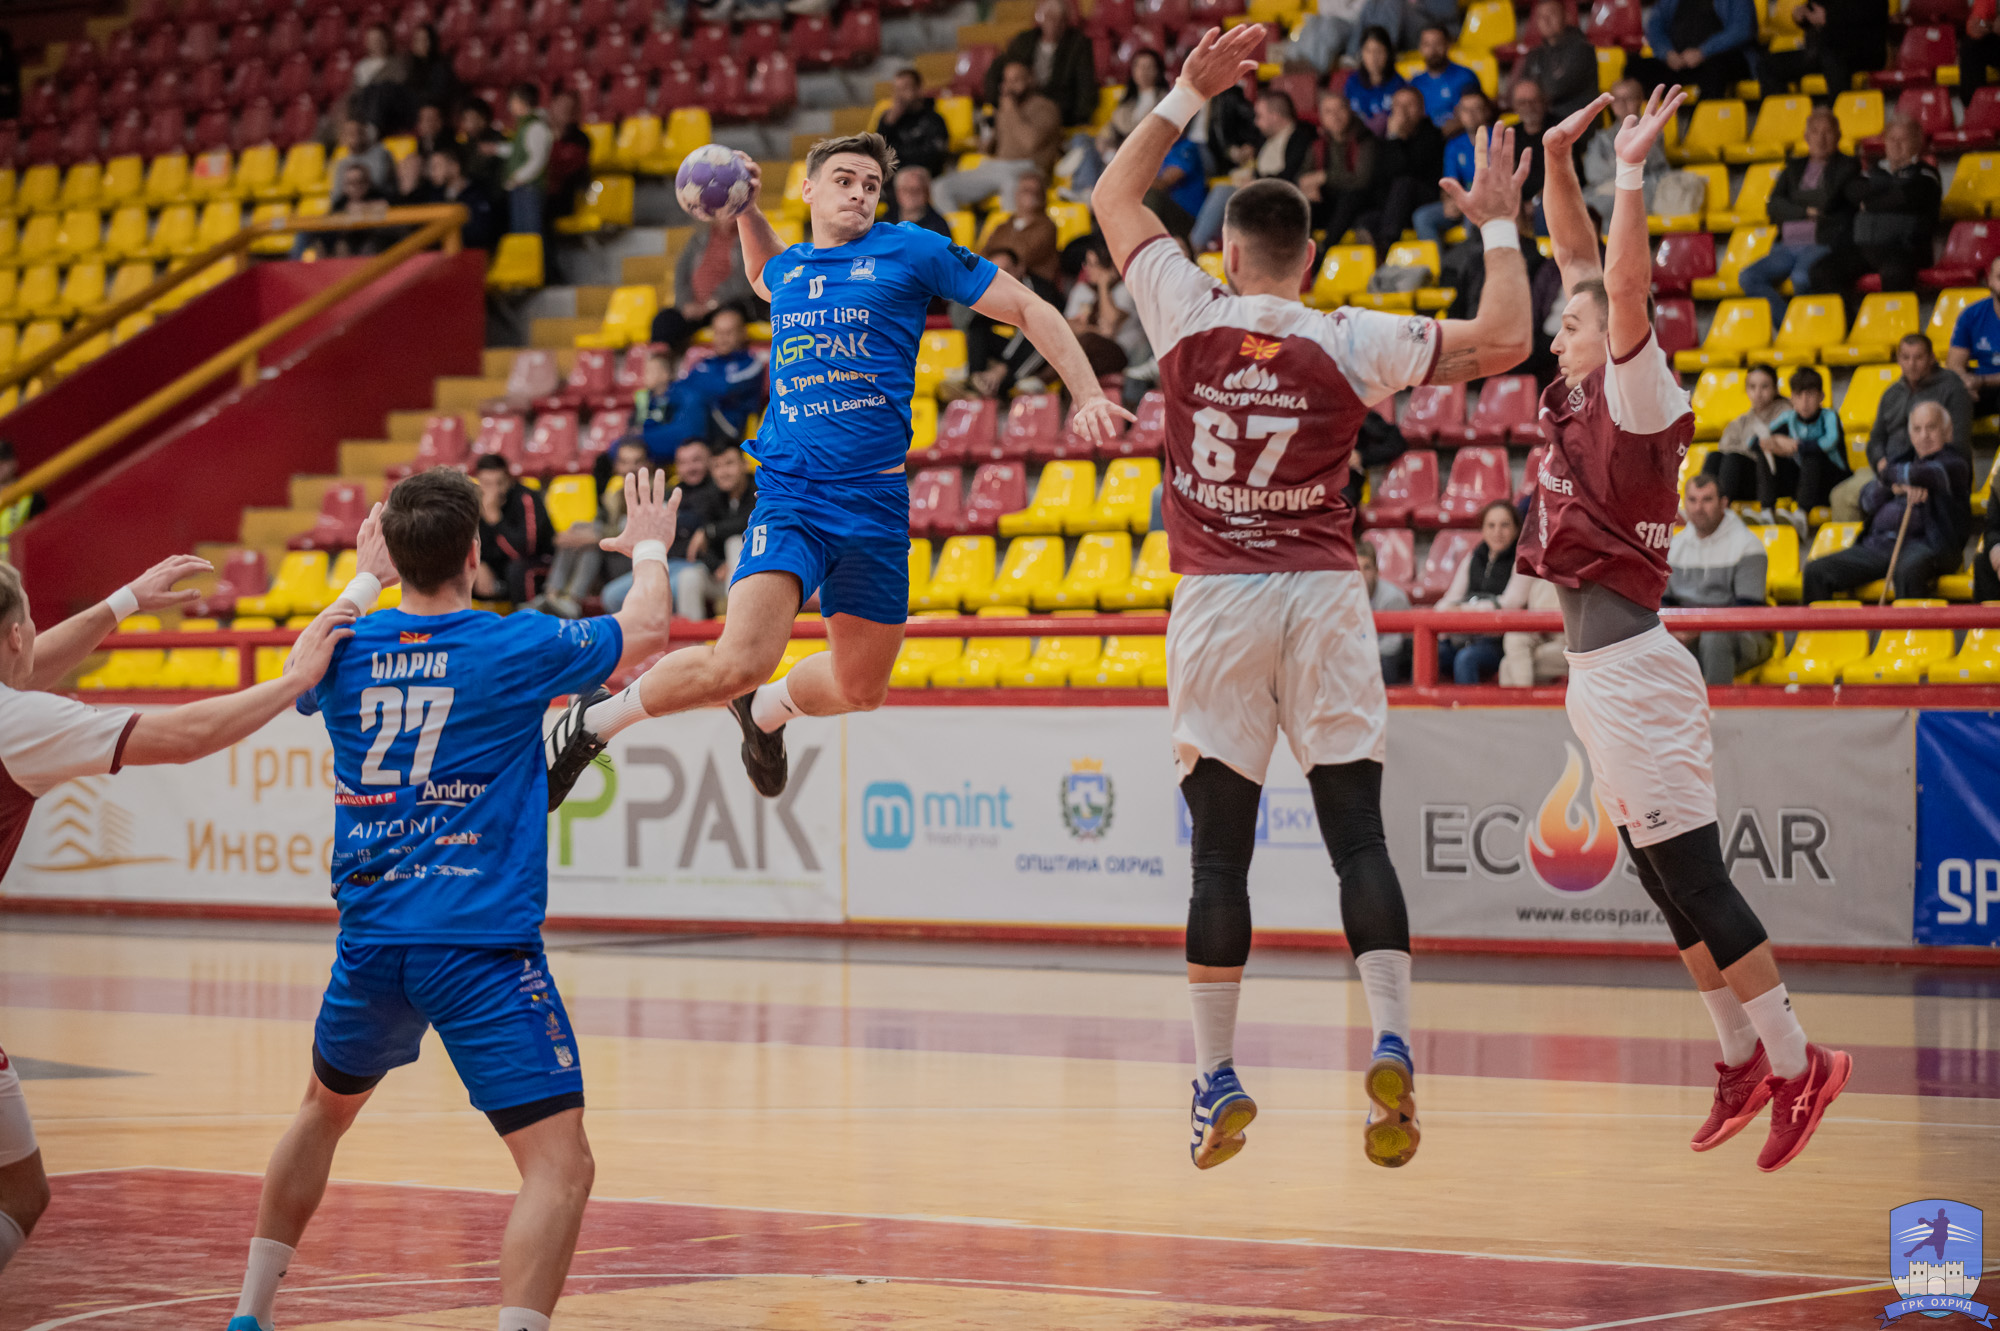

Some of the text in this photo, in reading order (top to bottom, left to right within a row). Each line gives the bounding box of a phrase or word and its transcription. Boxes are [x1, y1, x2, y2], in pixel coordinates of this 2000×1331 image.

[775, 332, 872, 370] ASPPAK
[791, 376, 825, 392] Трпе
[1193, 382, 1309, 411] КОЖУВЧАНКА
[803, 401, 830, 418] LTH
[1191, 406, 1300, 488] 67
[751, 524, 767, 557] 6
[359, 685, 455, 786] 27
[924, 781, 1014, 830] mint
[1937, 857, 2000, 926] SP
